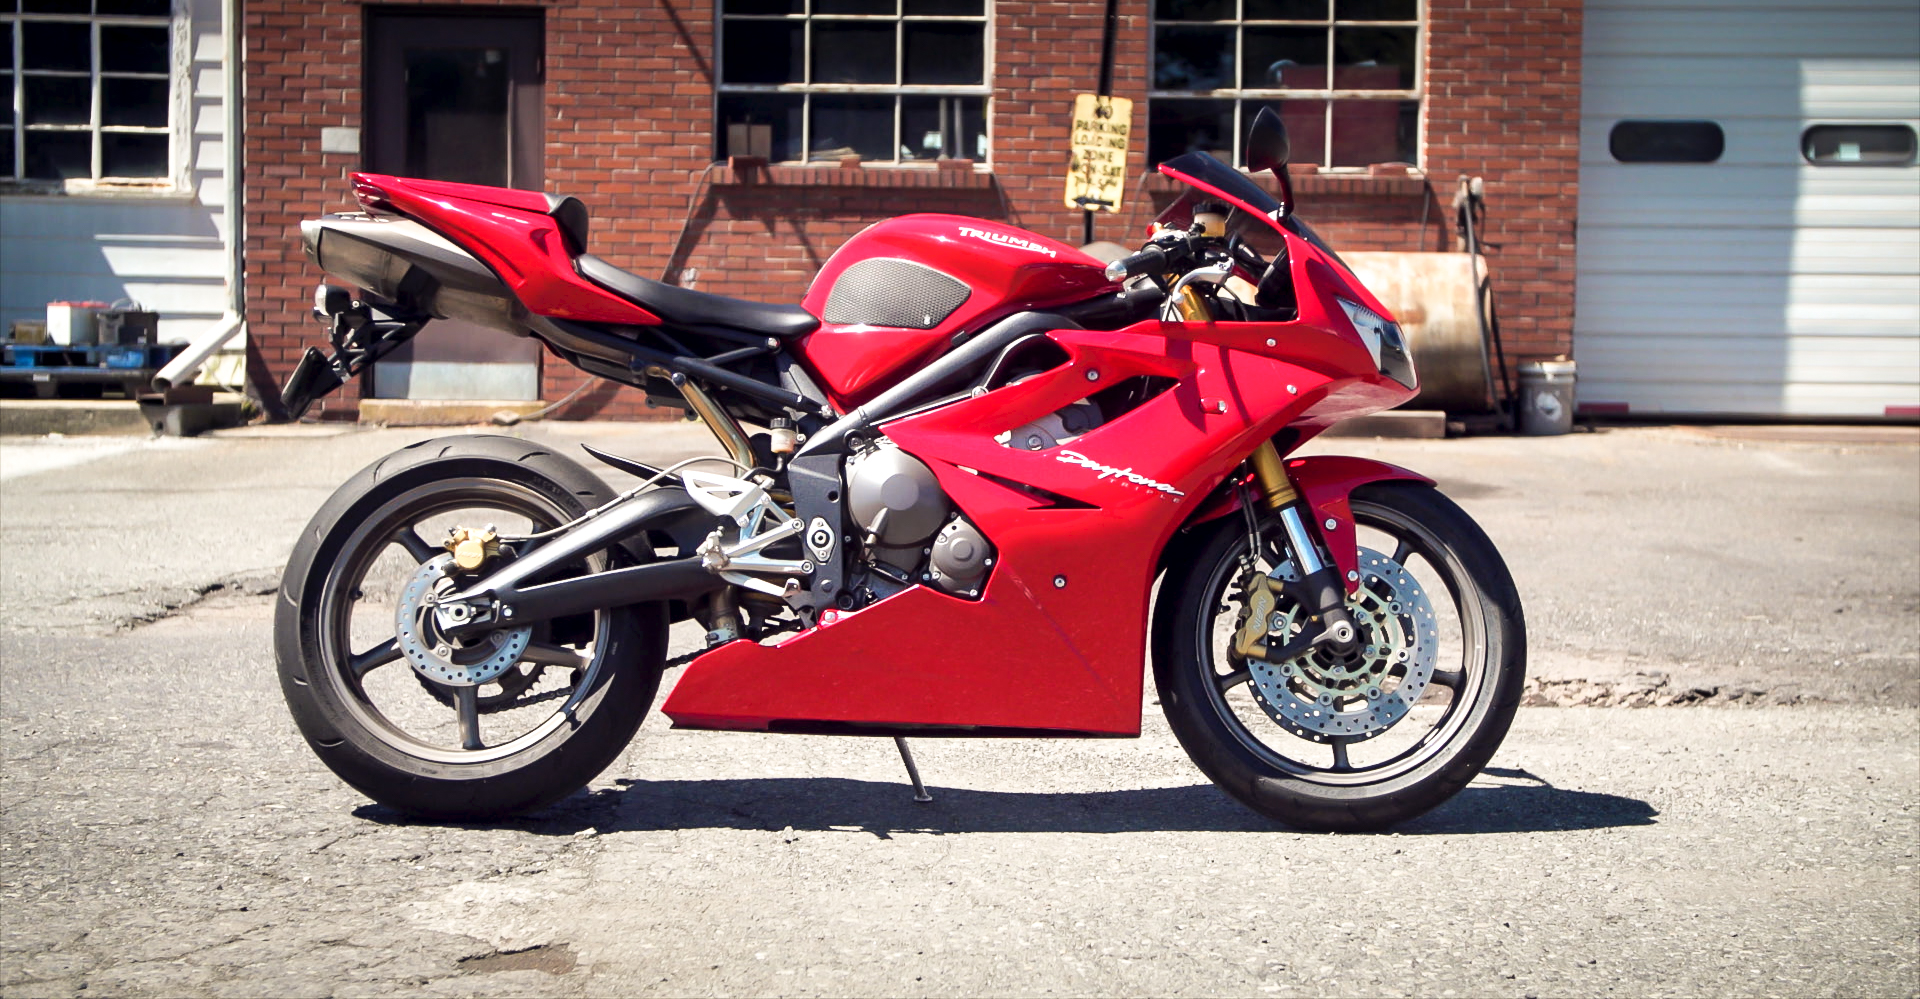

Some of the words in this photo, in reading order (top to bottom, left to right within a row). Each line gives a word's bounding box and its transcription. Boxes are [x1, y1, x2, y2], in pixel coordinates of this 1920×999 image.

[1076, 120, 1127, 136] PARKING
[1083, 149, 1114, 162] ZONE
[958, 226, 1057, 258] TRIUMPH
[1056, 450, 1185, 496] Daytona
